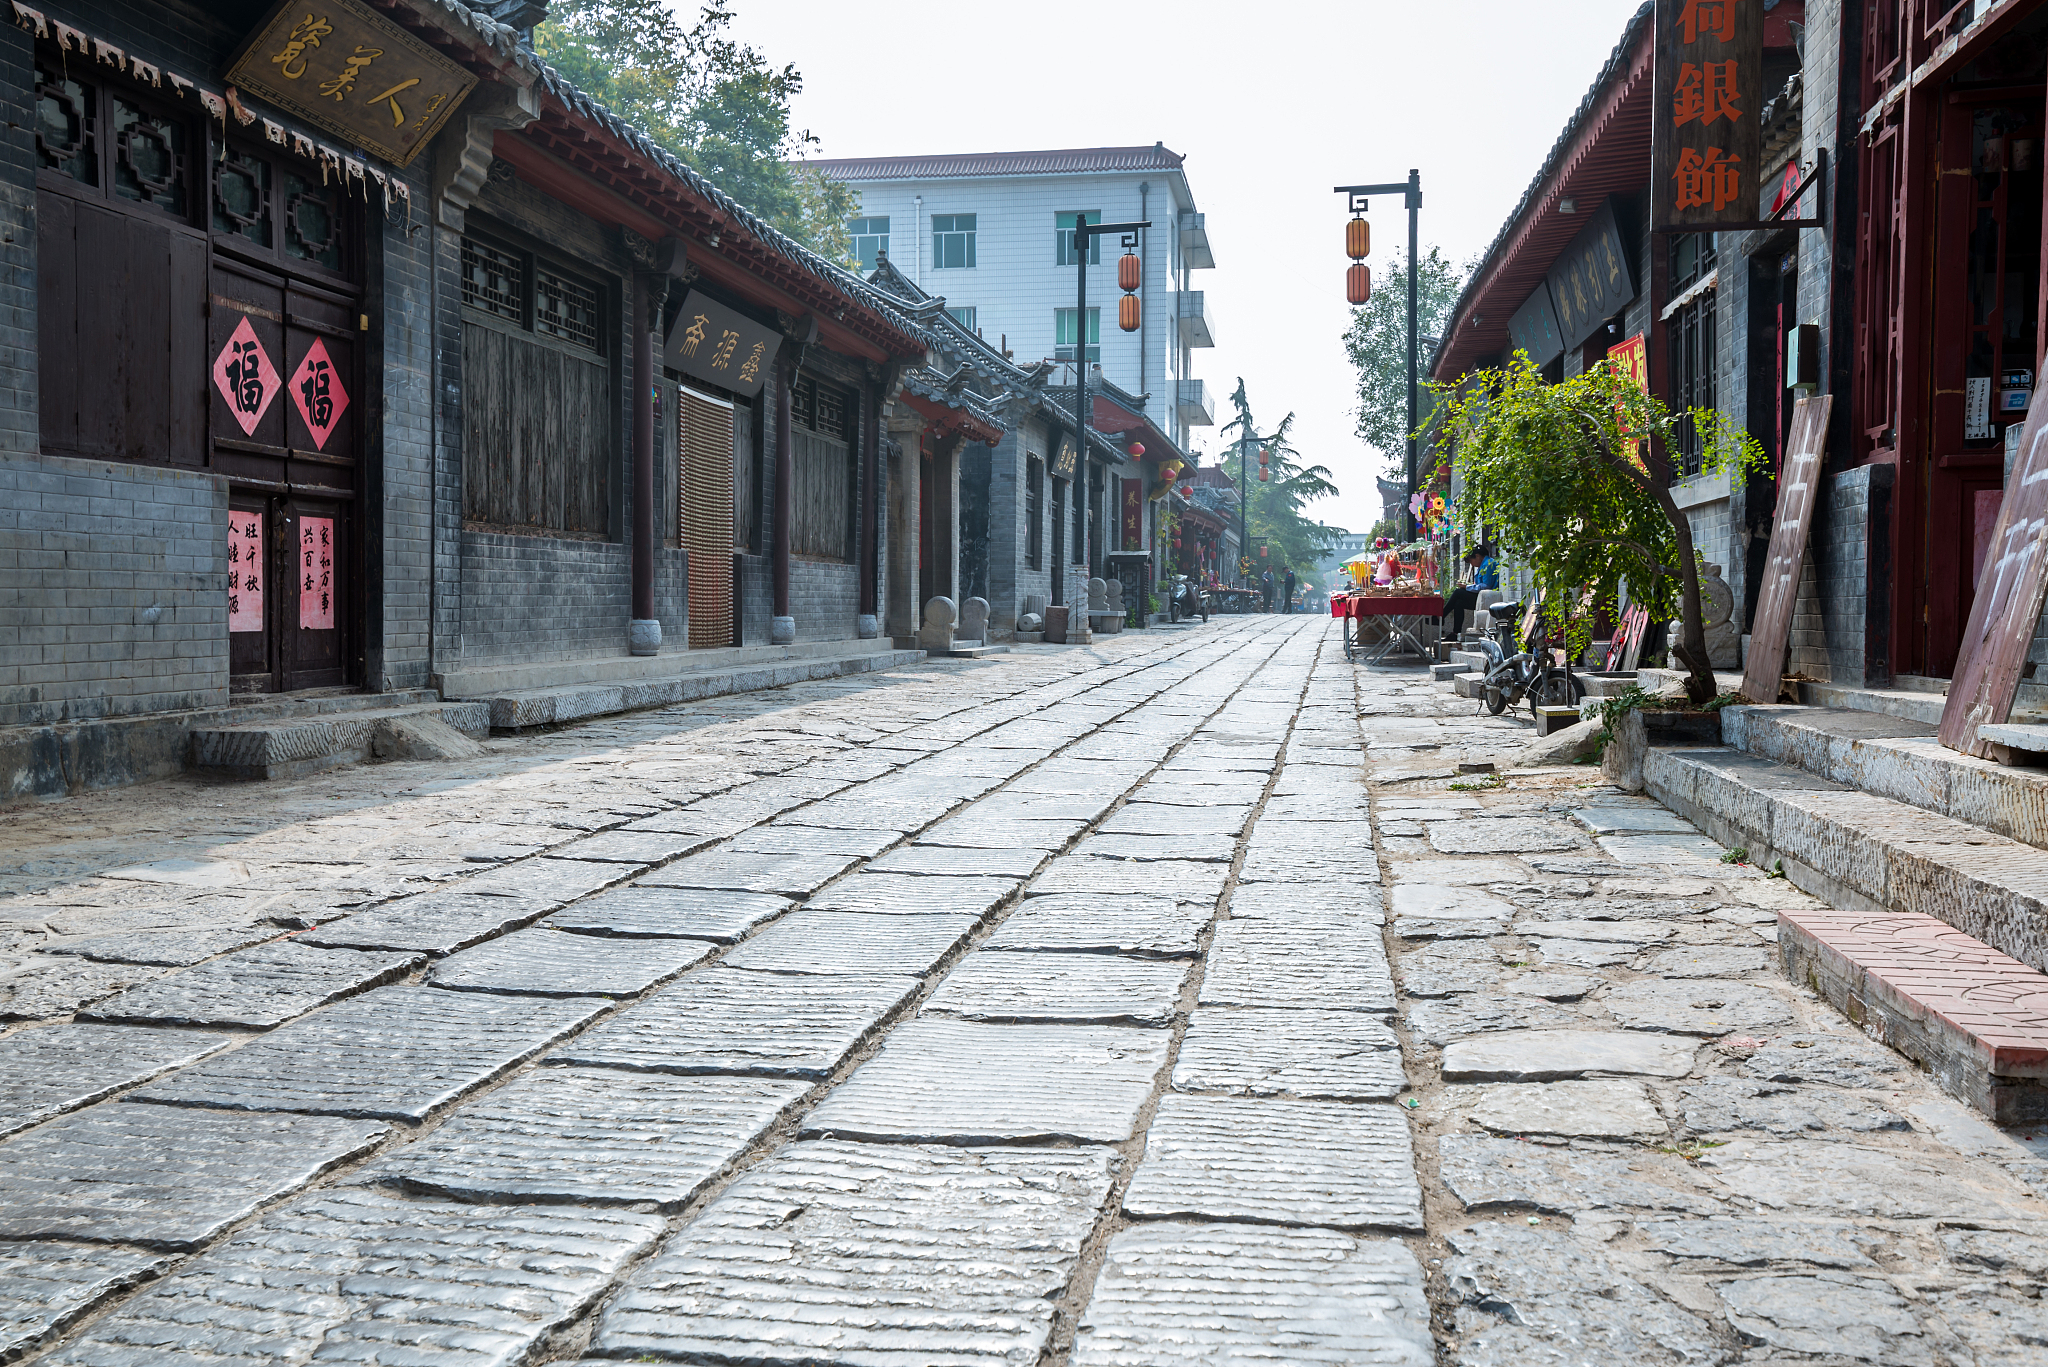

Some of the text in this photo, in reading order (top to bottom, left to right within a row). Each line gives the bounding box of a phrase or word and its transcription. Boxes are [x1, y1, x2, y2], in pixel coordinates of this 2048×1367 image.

[225, 341, 264, 415] 福
[301, 360, 333, 429] 福
[245, 523, 260, 591] 旺千秋
[320, 526, 331, 615] 家和万事
